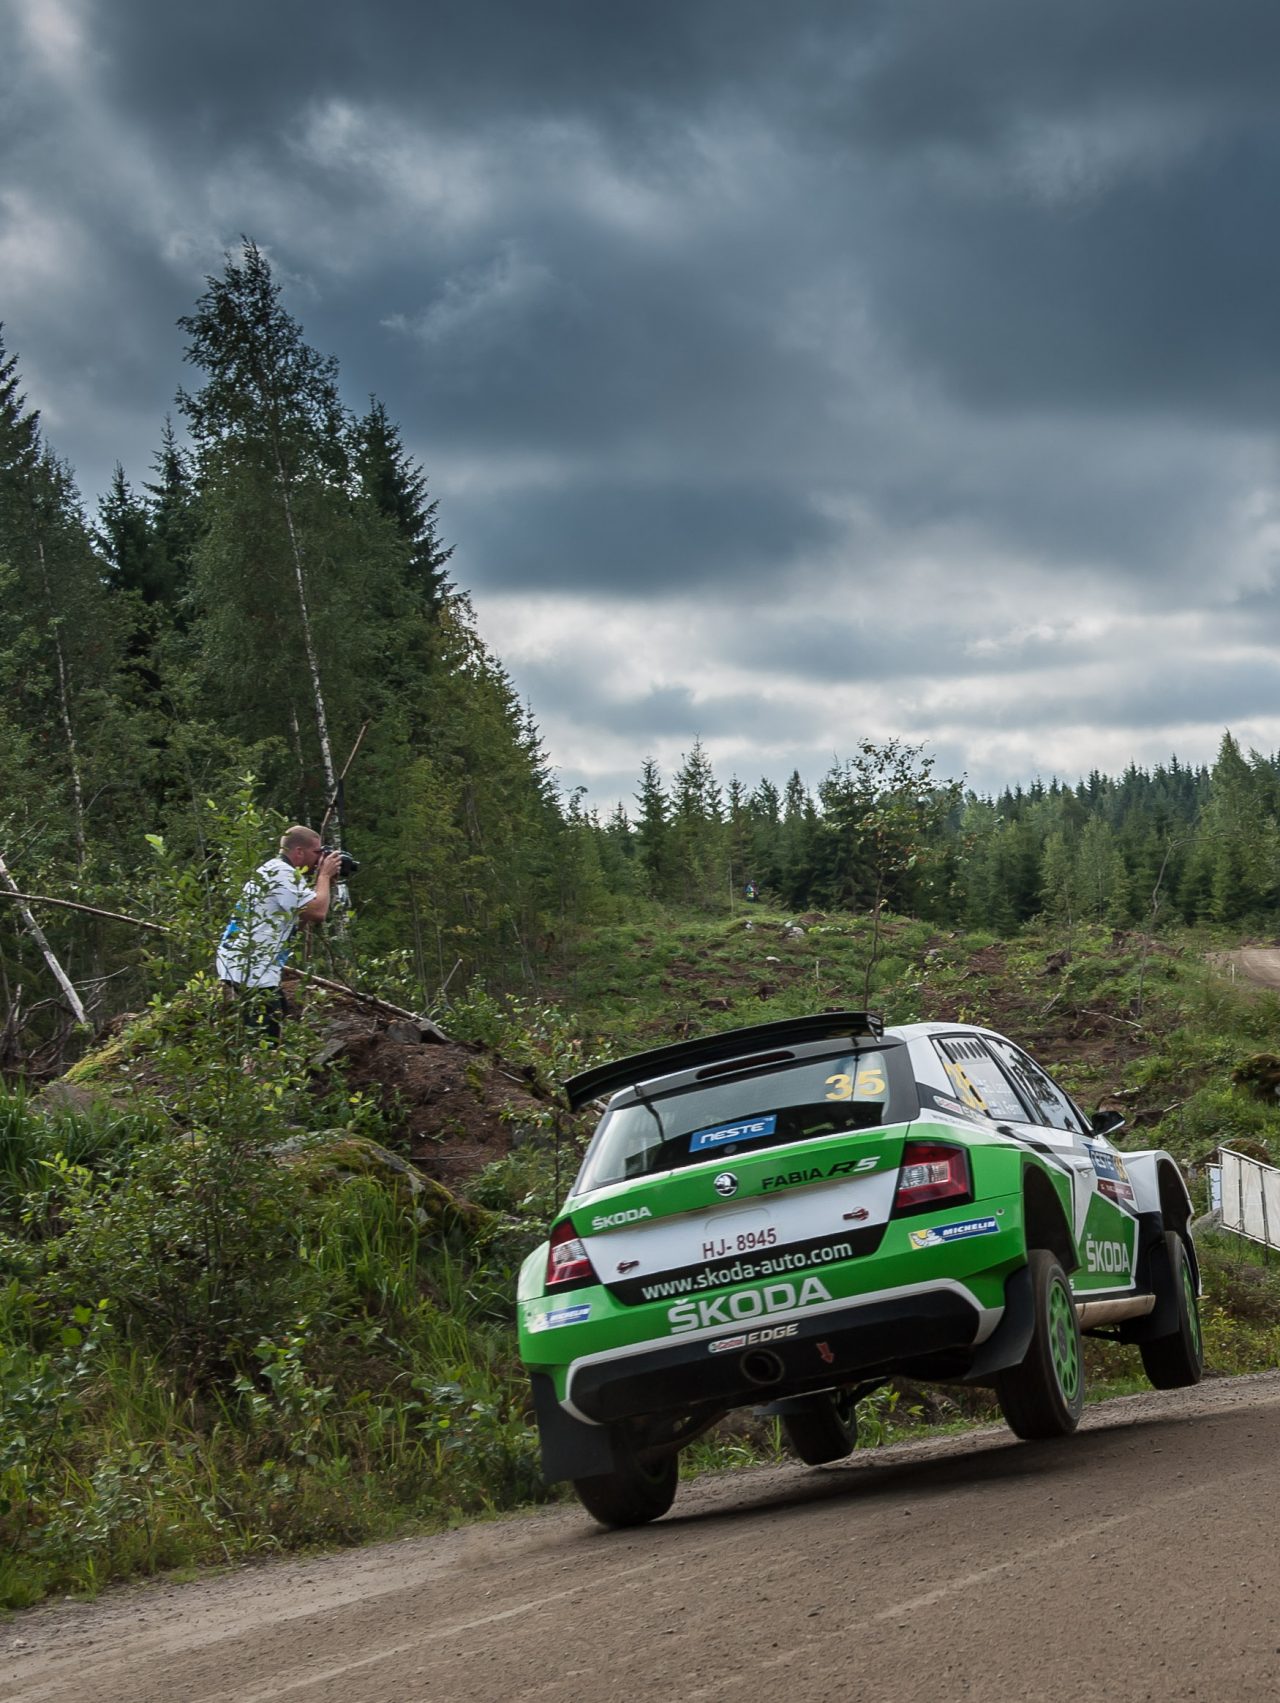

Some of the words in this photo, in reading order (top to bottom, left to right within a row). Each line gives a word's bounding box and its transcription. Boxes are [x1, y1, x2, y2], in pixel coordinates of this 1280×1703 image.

[825, 1069, 886, 1100] 35
[762, 1168, 823, 1190] FABIA
[827, 1156, 881, 1177] R5
[591, 1206, 652, 1231] ŠKODA
[942, 1220, 995, 1237] MICHELIN
[1086, 1233, 1131, 1273] ŠKODA
[641, 1243, 852, 1300] www.skoda-auto.com
[667, 1276, 832, 1334] ŠKODA
[748, 1323, 799, 1345] EDGE
